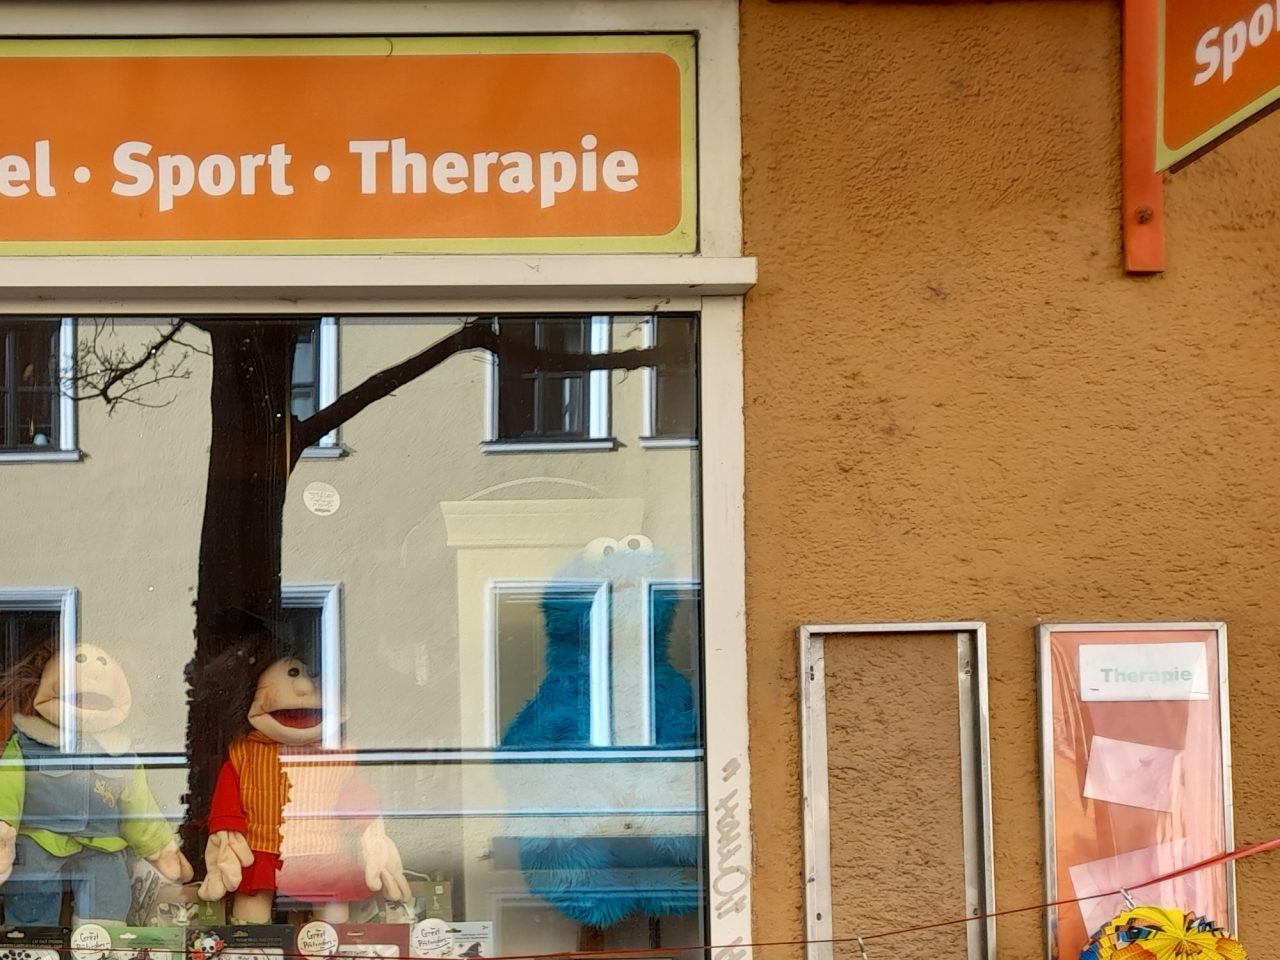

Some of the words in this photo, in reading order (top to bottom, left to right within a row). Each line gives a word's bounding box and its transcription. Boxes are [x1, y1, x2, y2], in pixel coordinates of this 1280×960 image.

[1193, 0, 1280, 85] Spo
[110, 140, 294, 212] Sport
[348, 134, 639, 209] Therapie
[1101, 666, 1193, 685] Therapie
[80, 933, 99, 943] Great
[306, 929, 325, 939] Great
